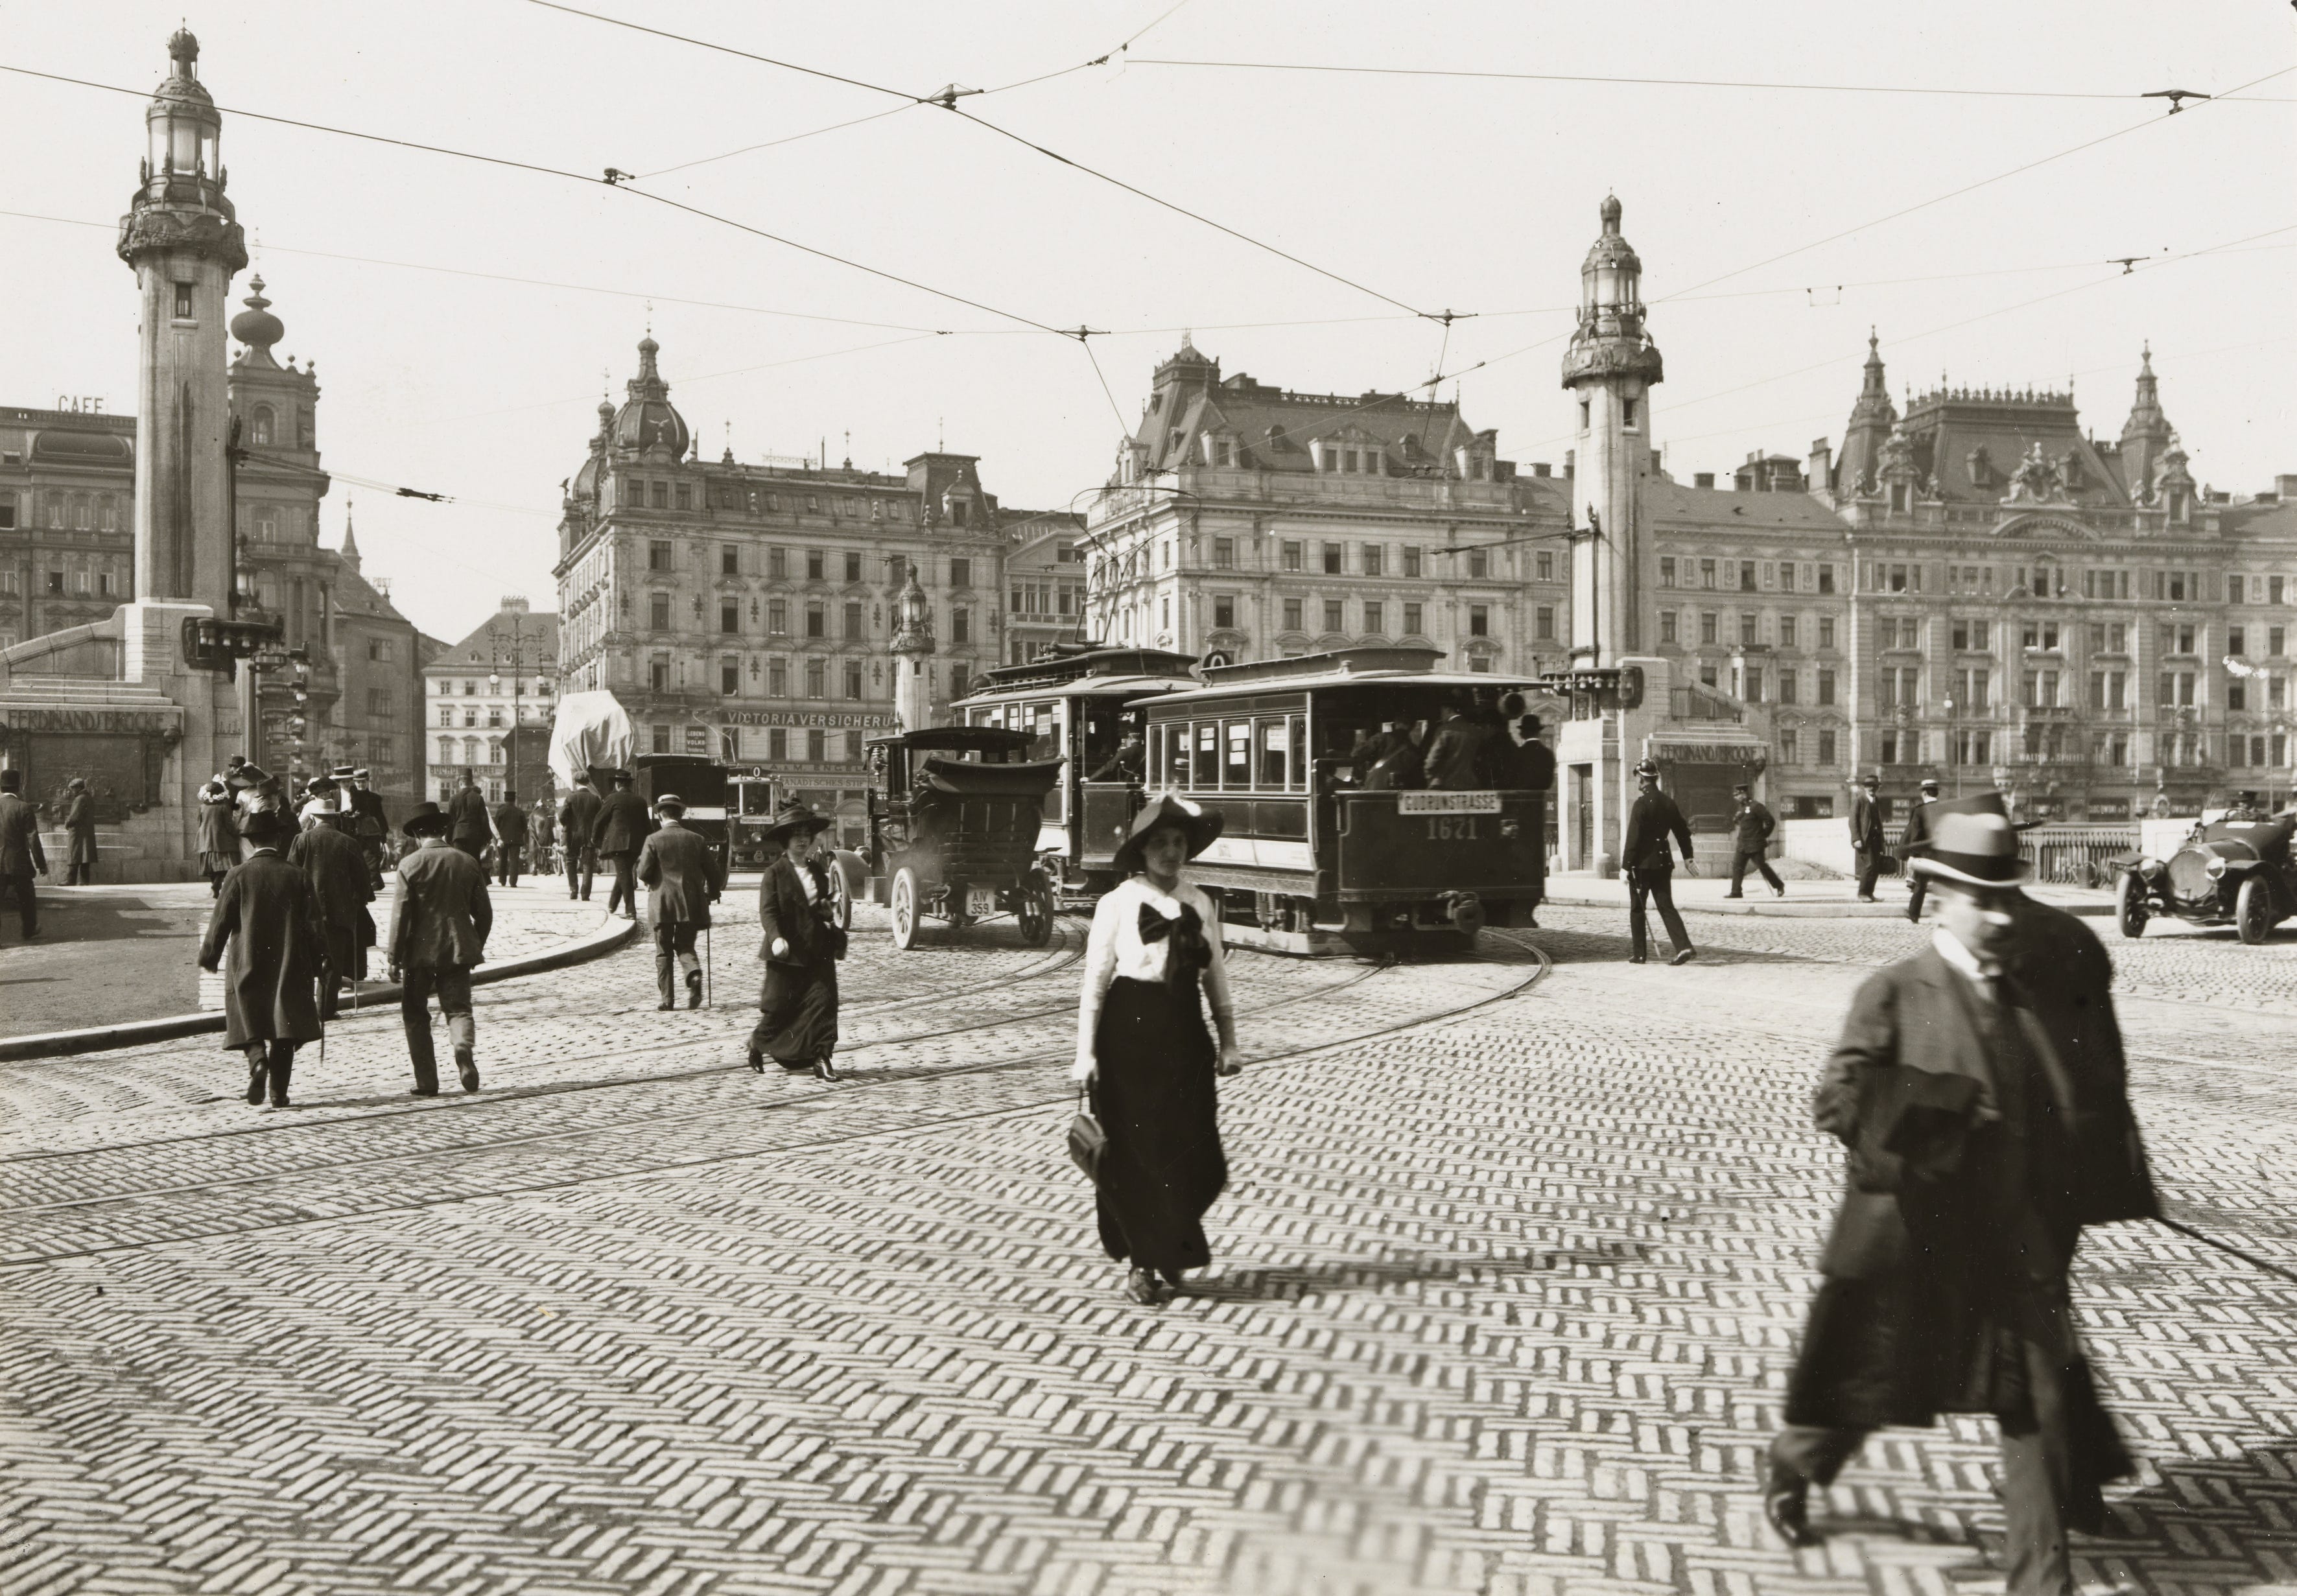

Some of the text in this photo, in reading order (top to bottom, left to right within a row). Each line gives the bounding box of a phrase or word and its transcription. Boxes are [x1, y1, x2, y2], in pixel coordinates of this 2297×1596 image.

[728, 712, 891, 727] VICTORIA VERSICHERU
[971, 903, 989, 915] 359
